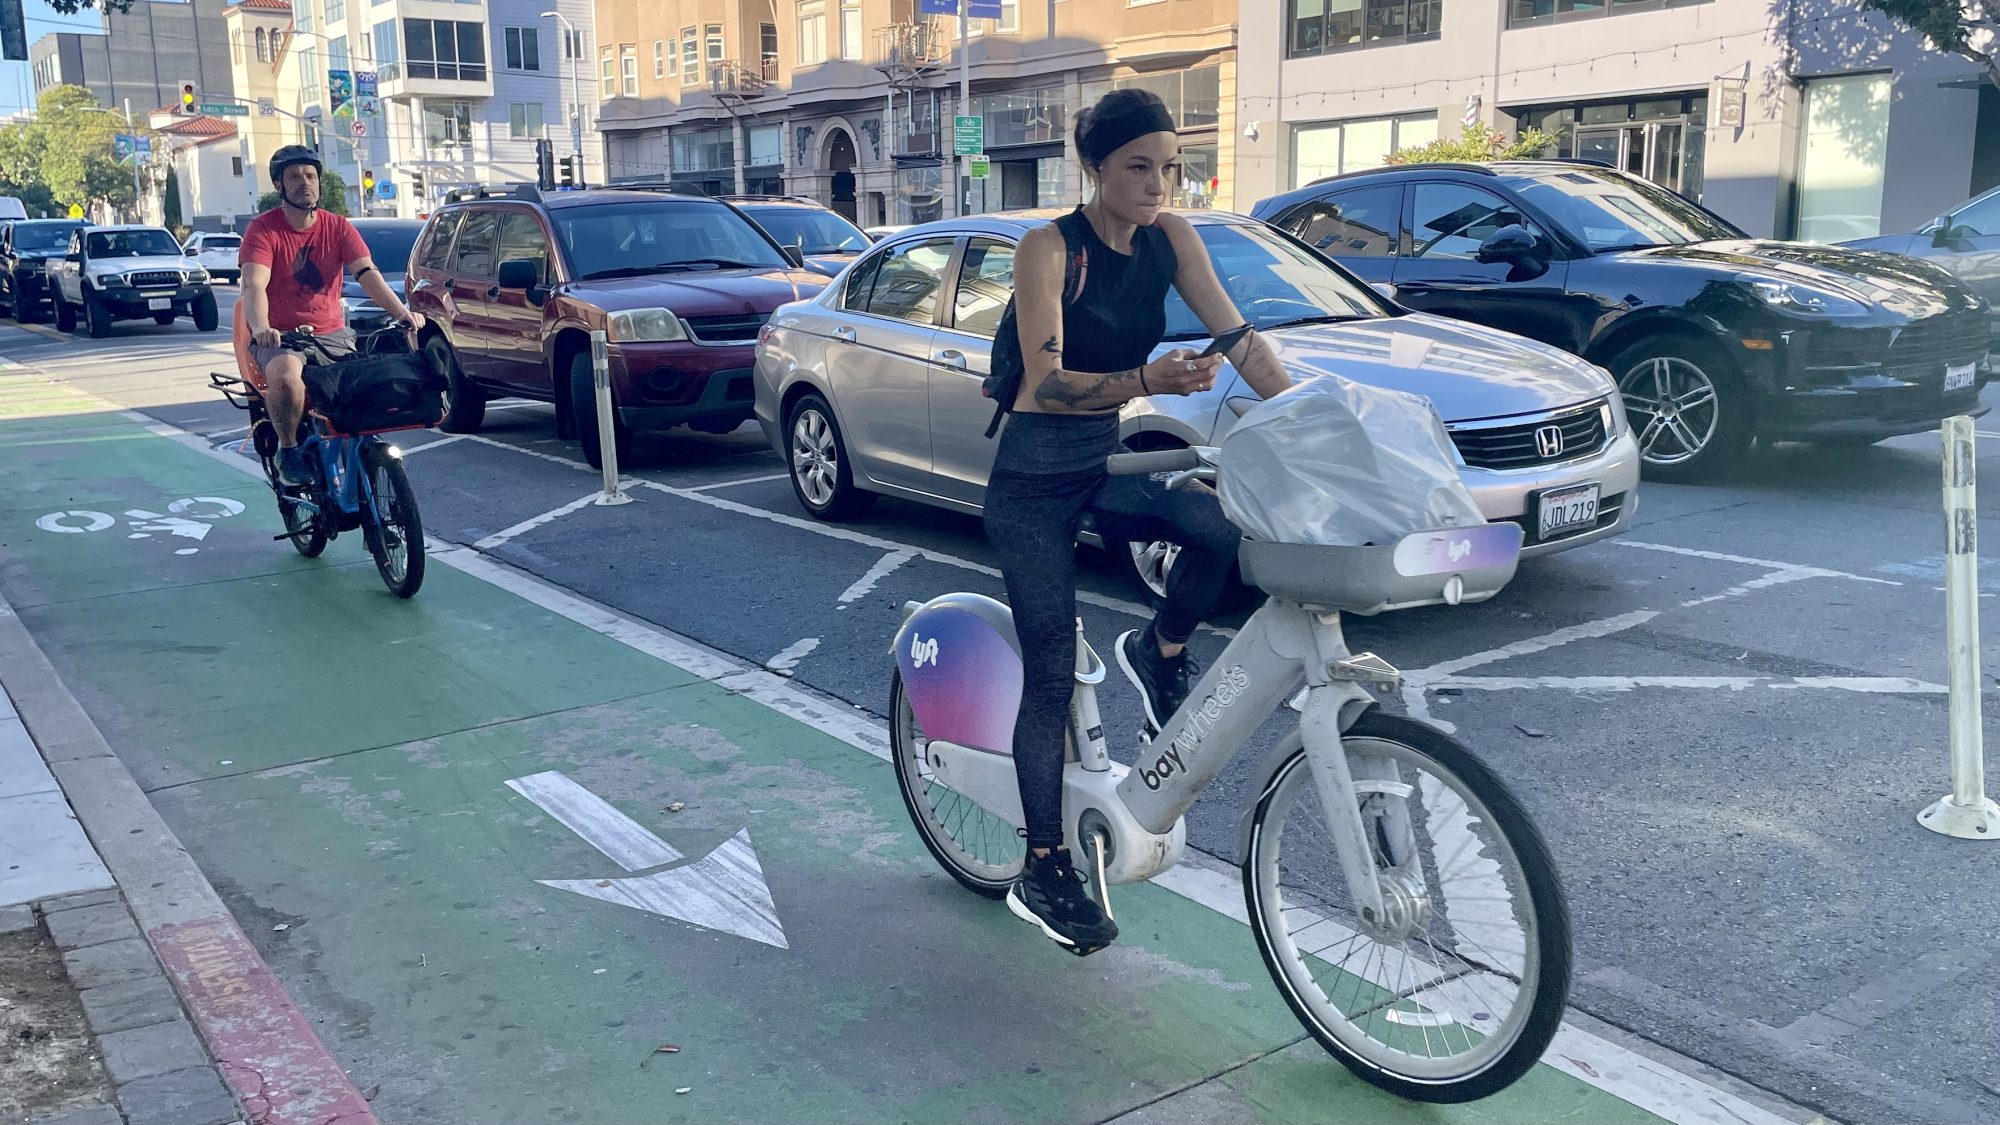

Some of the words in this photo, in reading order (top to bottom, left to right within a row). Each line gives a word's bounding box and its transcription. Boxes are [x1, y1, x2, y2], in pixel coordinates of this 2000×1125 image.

[223, 106, 246, 114] Street
[260, 106, 273, 115] 20
[1542, 500, 1595, 532] 6JDL219
[911, 632, 939, 669] lyft
